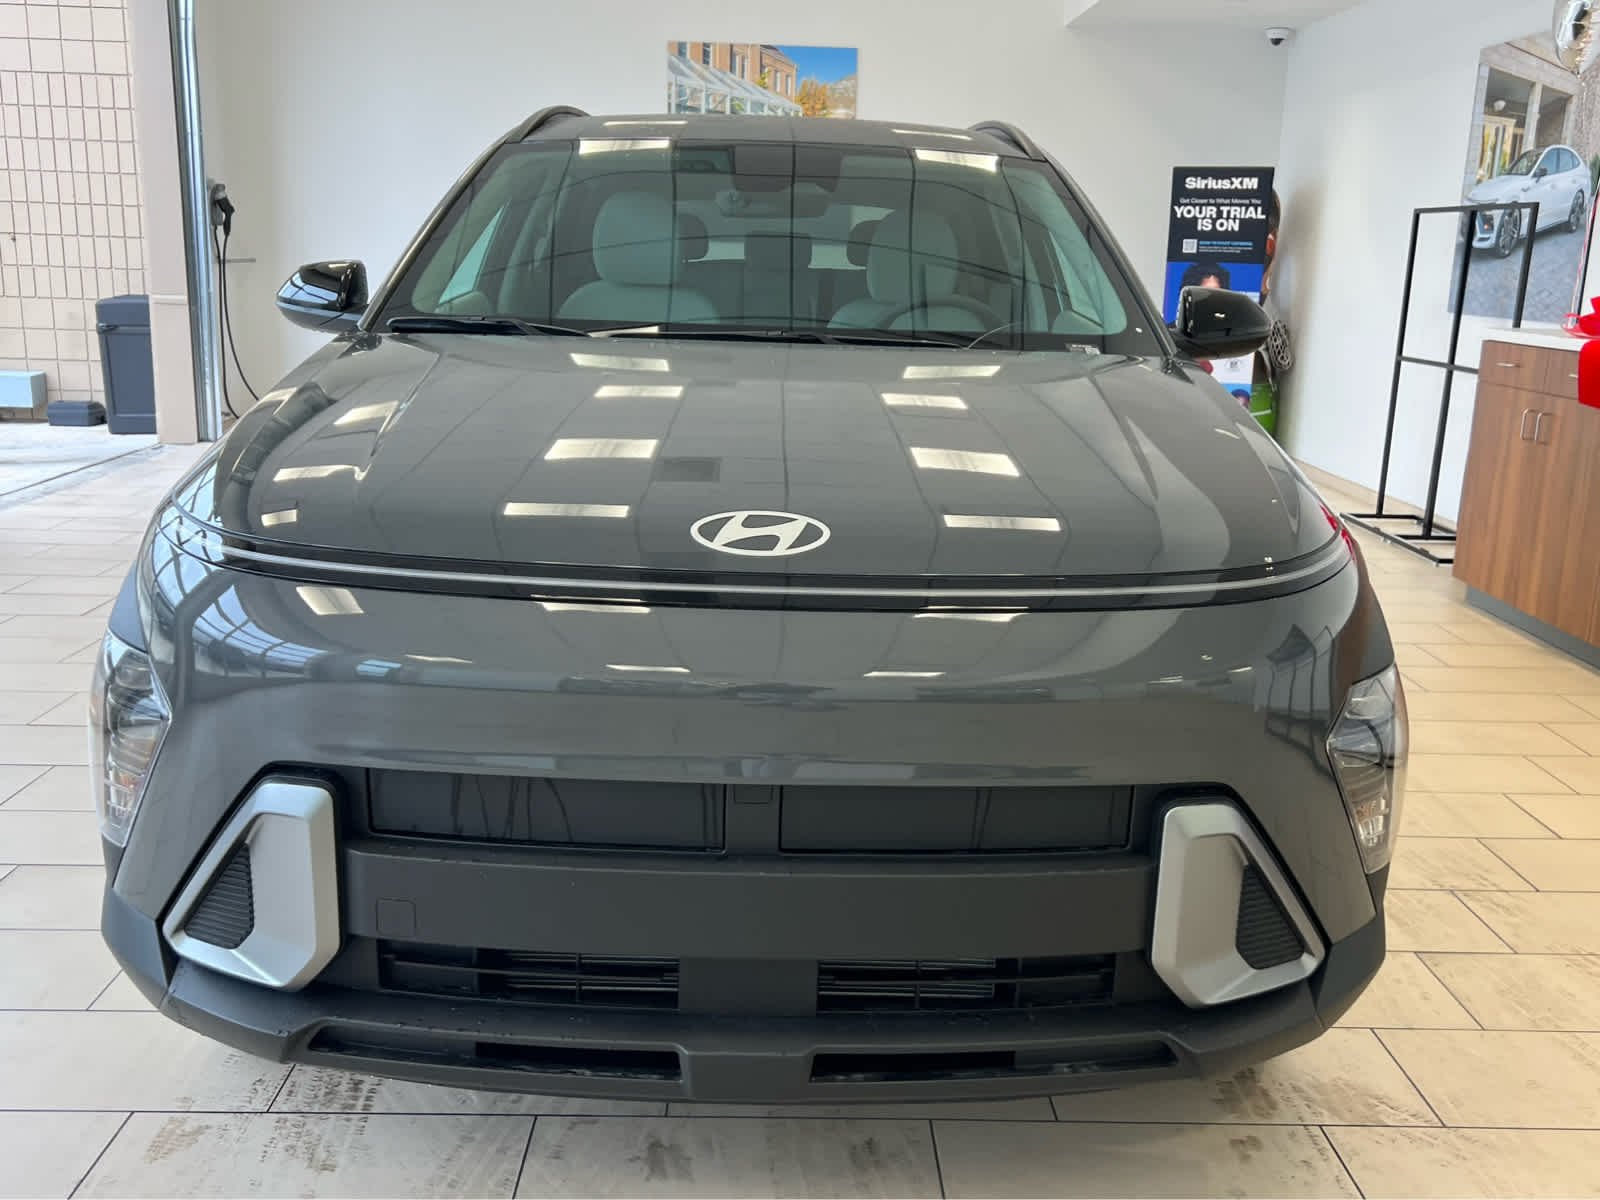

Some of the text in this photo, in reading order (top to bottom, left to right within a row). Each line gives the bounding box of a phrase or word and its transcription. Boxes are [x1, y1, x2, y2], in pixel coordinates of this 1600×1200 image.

[1185, 177, 1259, 190] SiriusXM
[1173, 206, 1266, 219] YOUR TRIAL
[1197, 218, 1240, 231] IS ON
